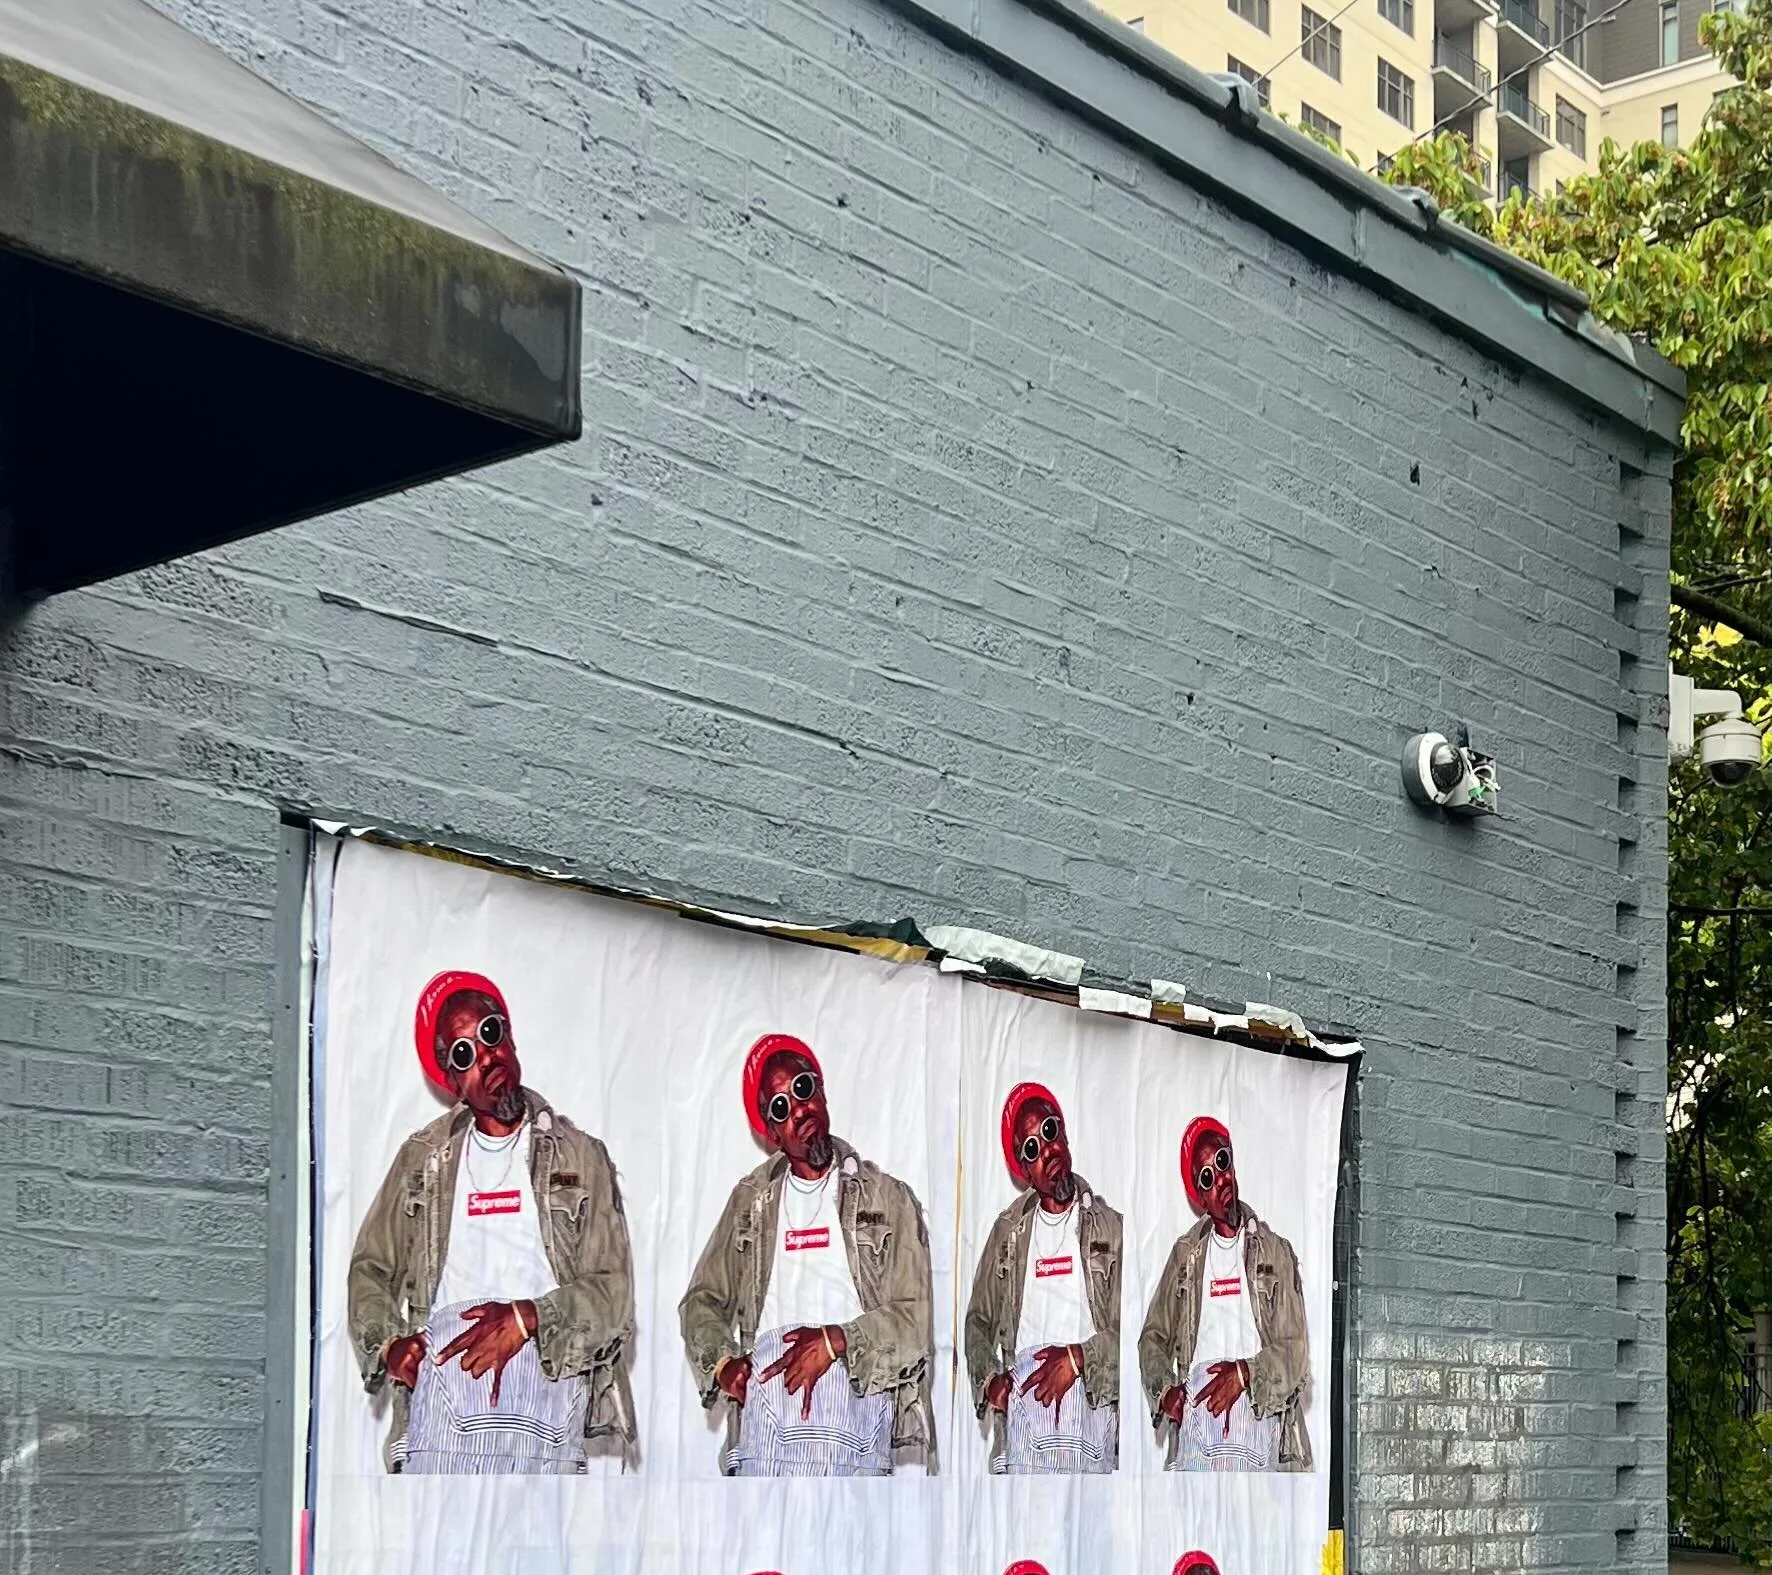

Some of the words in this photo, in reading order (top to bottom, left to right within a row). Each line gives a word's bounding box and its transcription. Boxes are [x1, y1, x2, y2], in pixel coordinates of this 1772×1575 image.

[469, 1194, 520, 1213] Supreme
[786, 1231, 828, 1249] Supreme
[1036, 1260, 1072, 1274] Supreme
